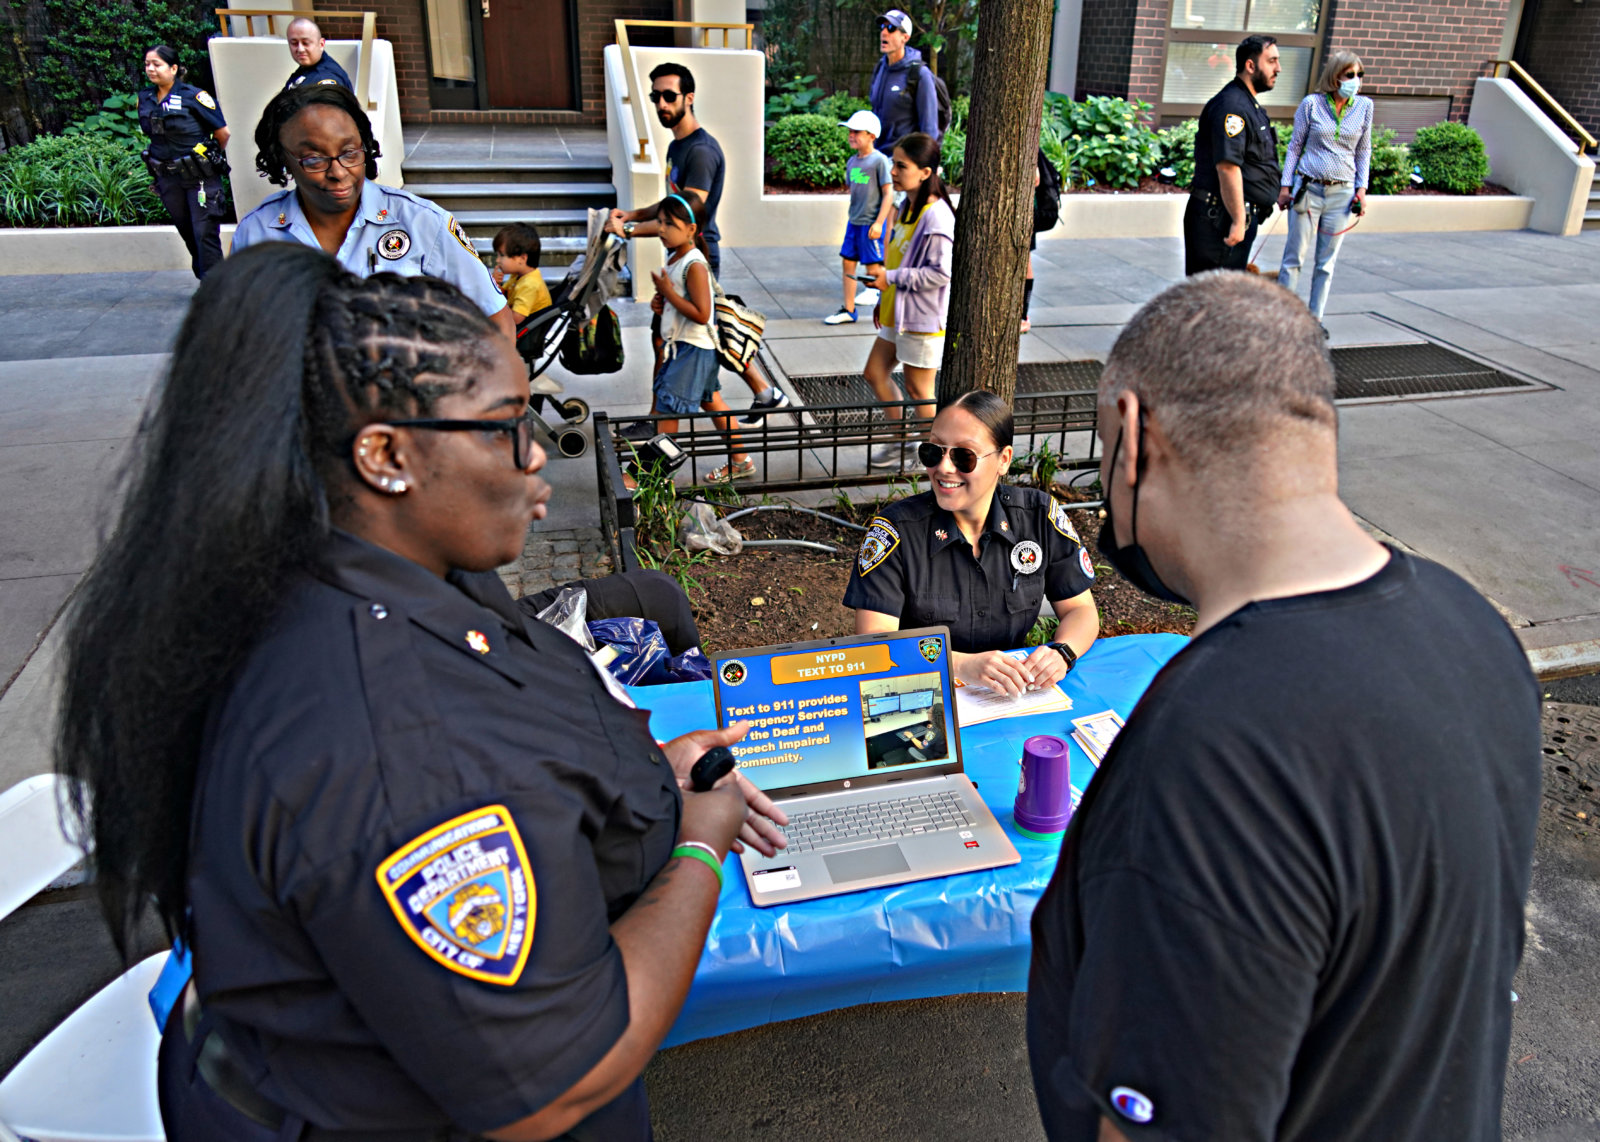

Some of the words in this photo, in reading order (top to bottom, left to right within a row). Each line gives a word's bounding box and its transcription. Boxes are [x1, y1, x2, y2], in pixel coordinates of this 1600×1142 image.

[816, 652, 846, 663] NYPD
[797, 666, 826, 678] TEXT
[829, 664, 844, 674] TO
[847, 662, 866, 672] 911
[727, 705, 755, 717] Text
[757, 703, 771, 713] to
[773, 699, 795, 711] 911
[798, 694, 848, 709] provides
[728, 714, 795, 728] Eergency
[797, 707, 848, 721] Services
[749, 730, 770, 741] the
[772, 725, 800, 738] Deaf
[802, 722, 825, 734] and
[731, 742, 776, 757] Speech
[778, 734, 831, 750] Impaired
[421, 840, 483, 884] POLICE
[408, 846, 510, 915] DEPARTMENT
[510, 866, 528, 917] YORK
[421, 926, 460, 959] CITY
[457, 950, 486, 969] OF
[505, 917, 525, 956] NEW
